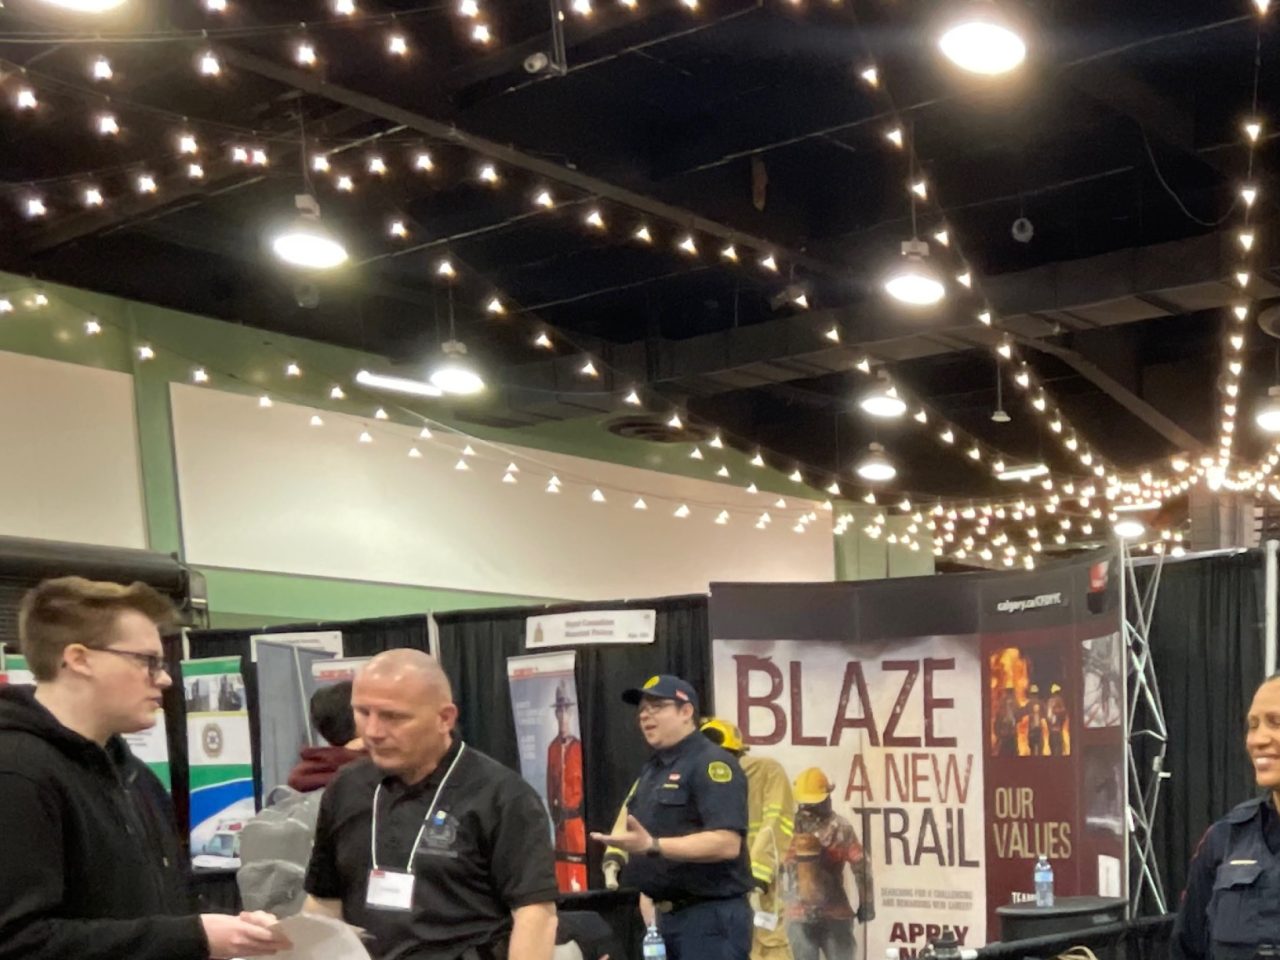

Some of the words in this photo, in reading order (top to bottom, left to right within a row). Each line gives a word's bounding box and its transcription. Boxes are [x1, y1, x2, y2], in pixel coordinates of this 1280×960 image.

[731, 654, 958, 748] BLAZE
[844, 753, 874, 802] A
[884, 752, 974, 804] NEW
[995, 787, 1034, 819] OUR
[852, 807, 980, 868] TRAIL
[993, 822, 1072, 859] VALUES
[889, 922, 969, 947] APPY
